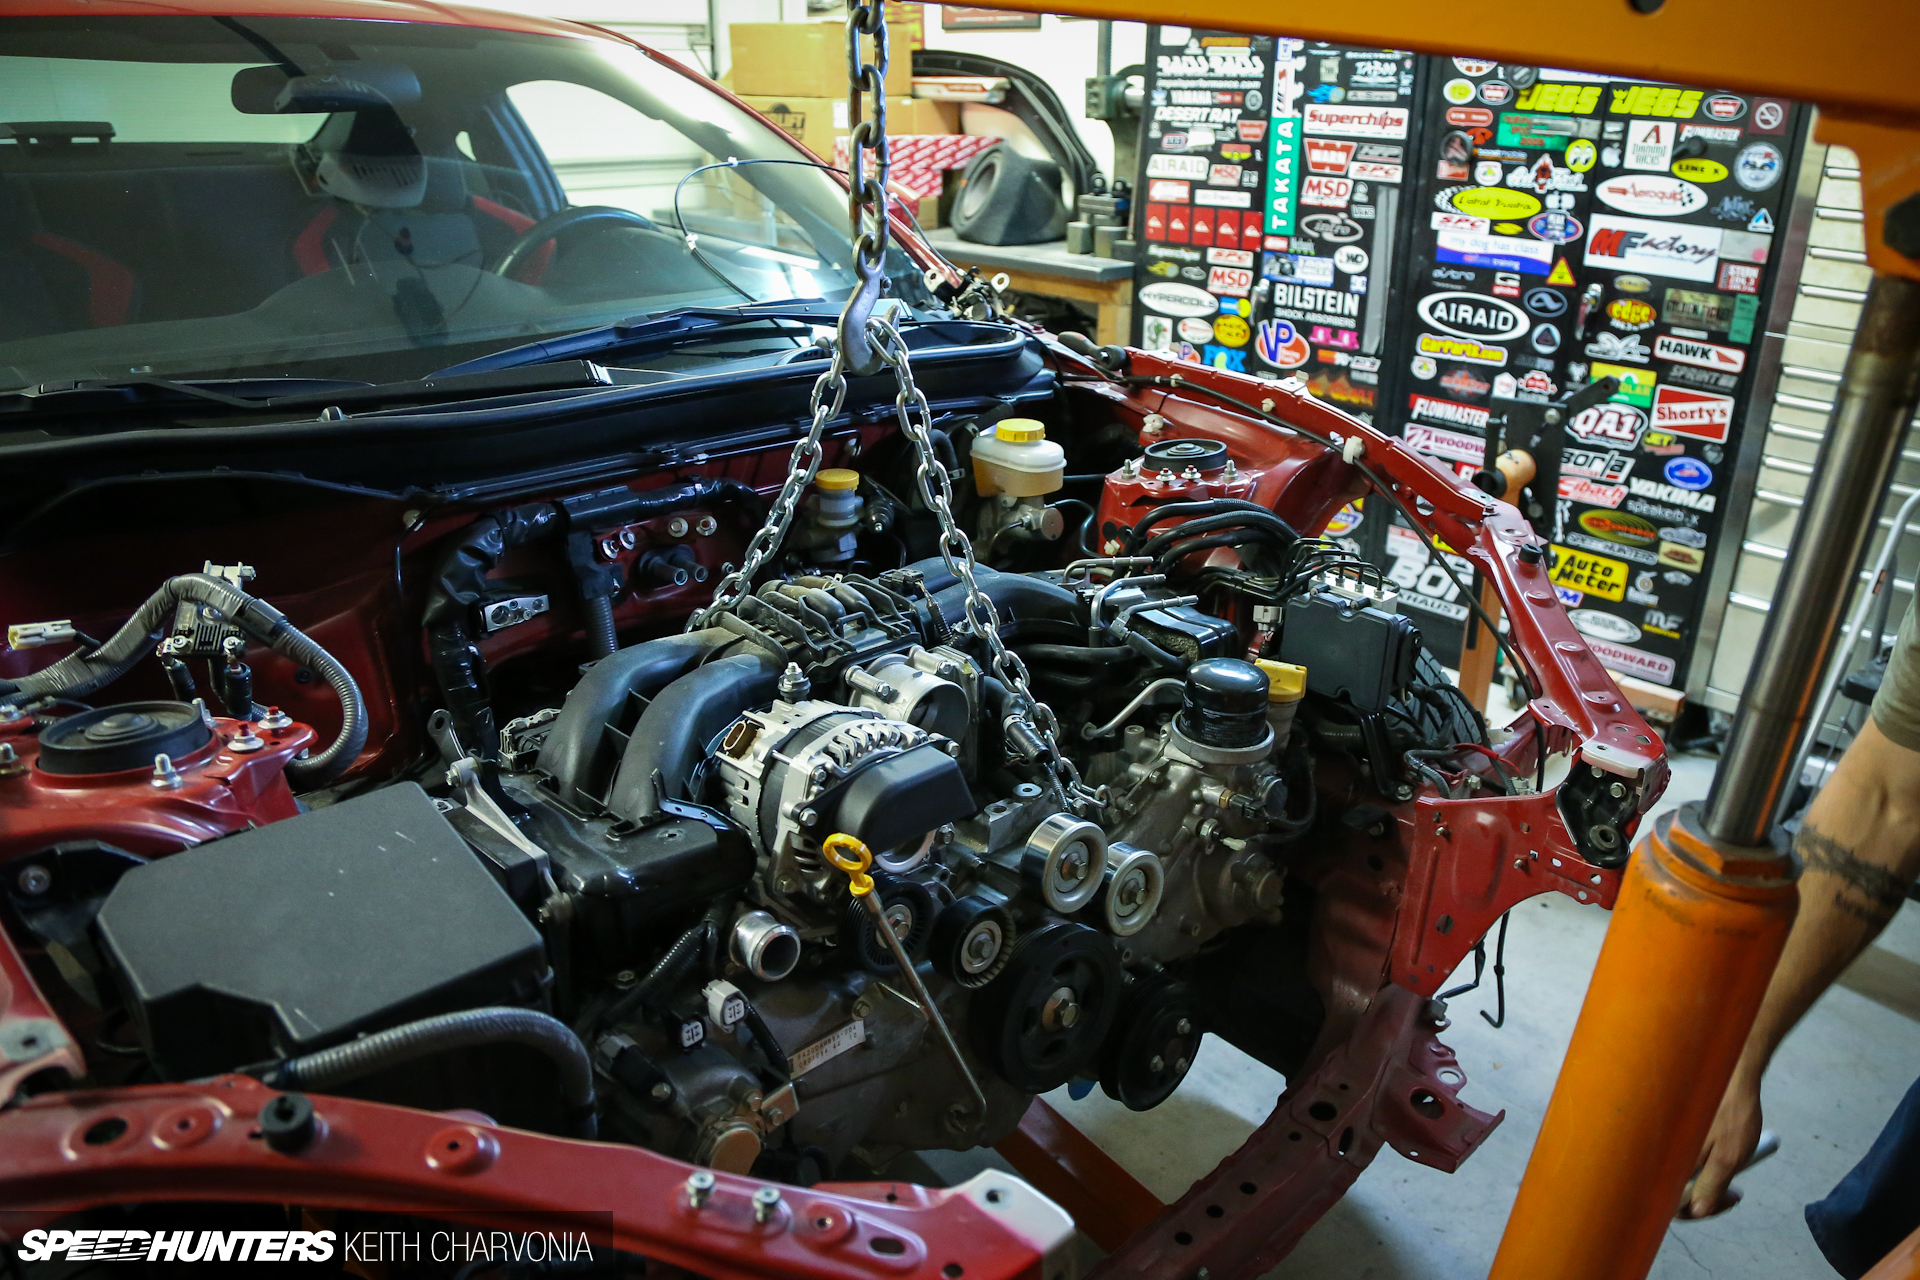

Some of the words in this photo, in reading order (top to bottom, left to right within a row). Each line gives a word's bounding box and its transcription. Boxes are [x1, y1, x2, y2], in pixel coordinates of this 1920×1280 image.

[1515, 83, 1603, 115] JEGS
[1609, 86, 1705, 119] JEGS
[1154, 106, 1211, 121] DESERT
[1208, 108, 1243, 124] RAT
[1307, 110, 1404, 130] Superchips
[1151, 158, 1206, 174] AIRAID
[1310, 149, 1348, 165] WARN
[1213, 165, 1240, 179] MSD
[1271, 121, 1294, 230] TAKATA
[1305, 179, 1350, 198] MSD
[1451, 237, 1466, 246] my
[1470, 236, 1490, 250] dog
[1493, 239, 1511, 251] has
[1514, 242, 1540, 254] class
[1211, 268, 1250, 287] MSD
[1273, 282, 1360, 317] BILSTEIN
[1274, 307, 1304, 320] SHOCK
[1305, 312, 1357, 329] ABSORBERS
[1433, 301, 1514, 332] AIRAID
[1261, 321, 1294, 363] VP
[1420, 336, 1504, 362] CarParts.com
[1659, 339, 1713, 360] HAWK
[1410, 397, 1490, 429] FLOWMASTER
[1573, 407, 1639, 442] QA1
[1657, 403, 1728, 424] Shorty's
[1629, 477, 1717, 512] YAKIMA
[1565, 554, 1614, 577] Auto
[1555, 568, 1621, 593] Meter
[1589, 643, 1668, 672] OODWARD
